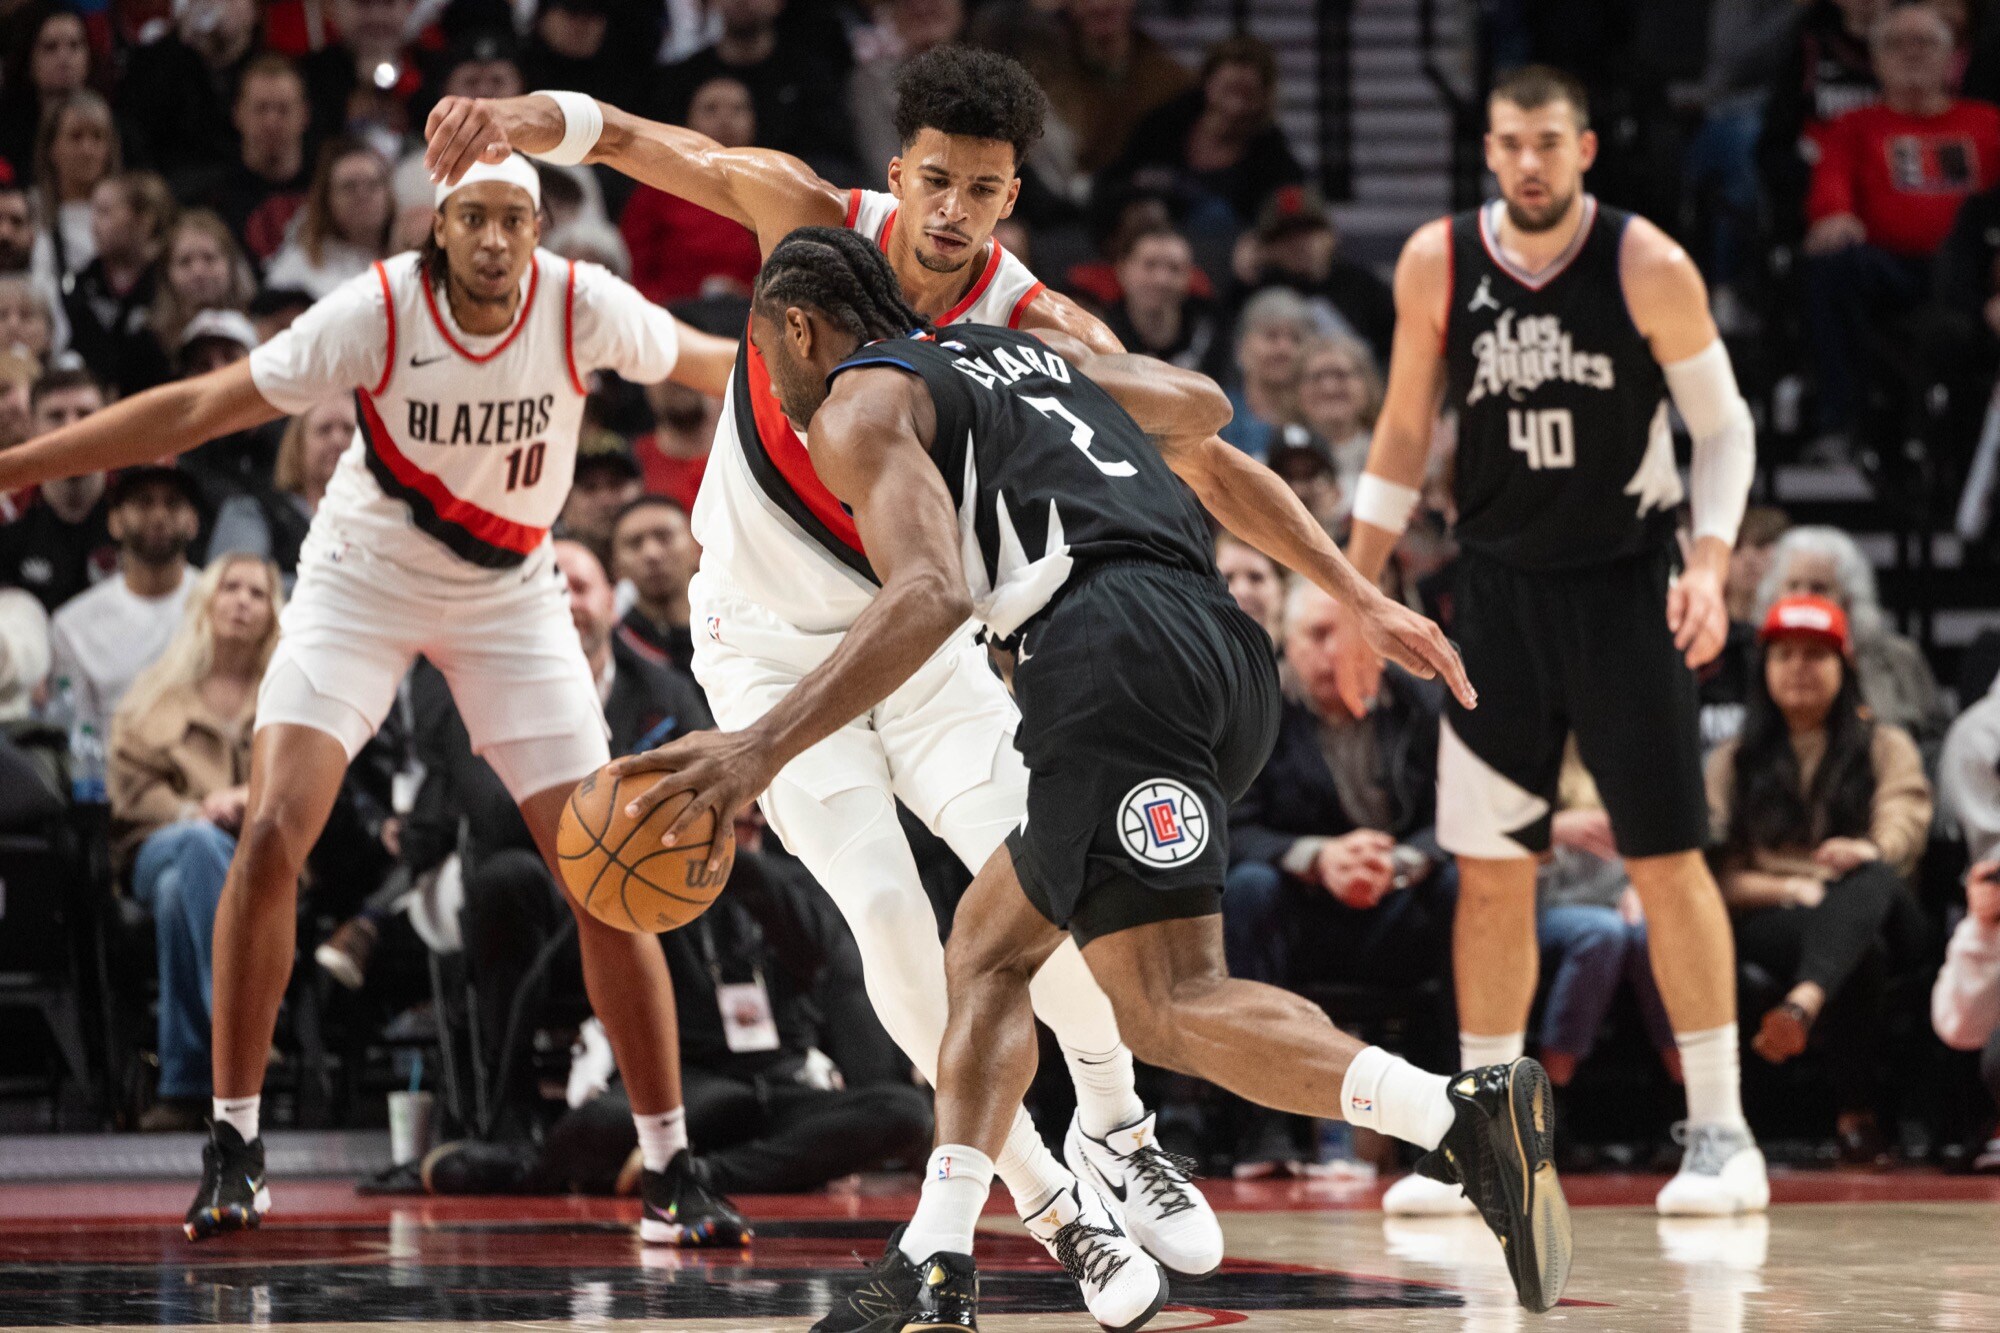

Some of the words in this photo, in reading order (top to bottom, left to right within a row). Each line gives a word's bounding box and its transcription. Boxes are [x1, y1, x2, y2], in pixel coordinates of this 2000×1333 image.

[1496, 309, 1560, 349] Los
[1466, 331, 1614, 406] Angeles
[406, 394, 554, 445] BLAZERS
[1017, 394, 1138, 477] 2
[1507, 408, 1575, 470] 40
[505, 441, 546, 493] 10
